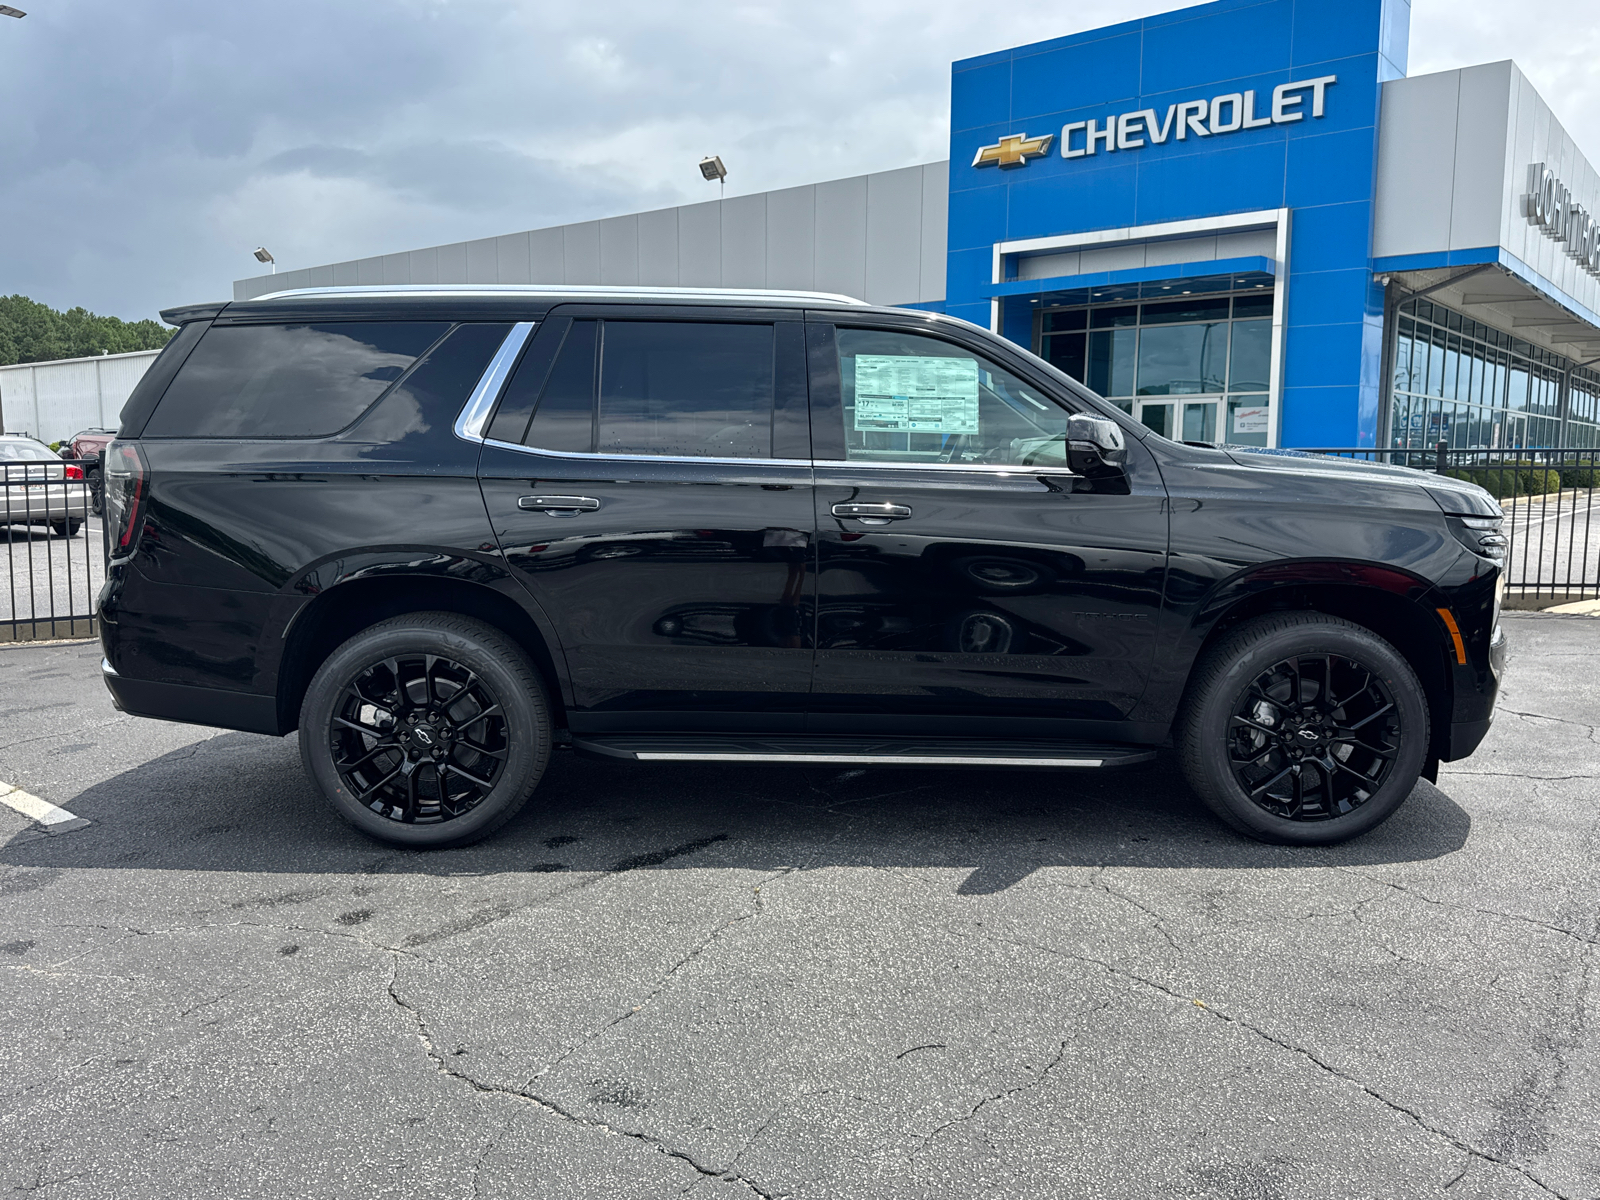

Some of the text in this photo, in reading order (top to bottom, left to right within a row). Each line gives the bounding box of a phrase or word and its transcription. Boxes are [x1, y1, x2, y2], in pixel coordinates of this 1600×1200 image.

[1062, 75, 1336, 158] CHEVROLET
[1528, 162, 1571, 242] JOHN
[1072, 611, 1148, 622] TAHOE
